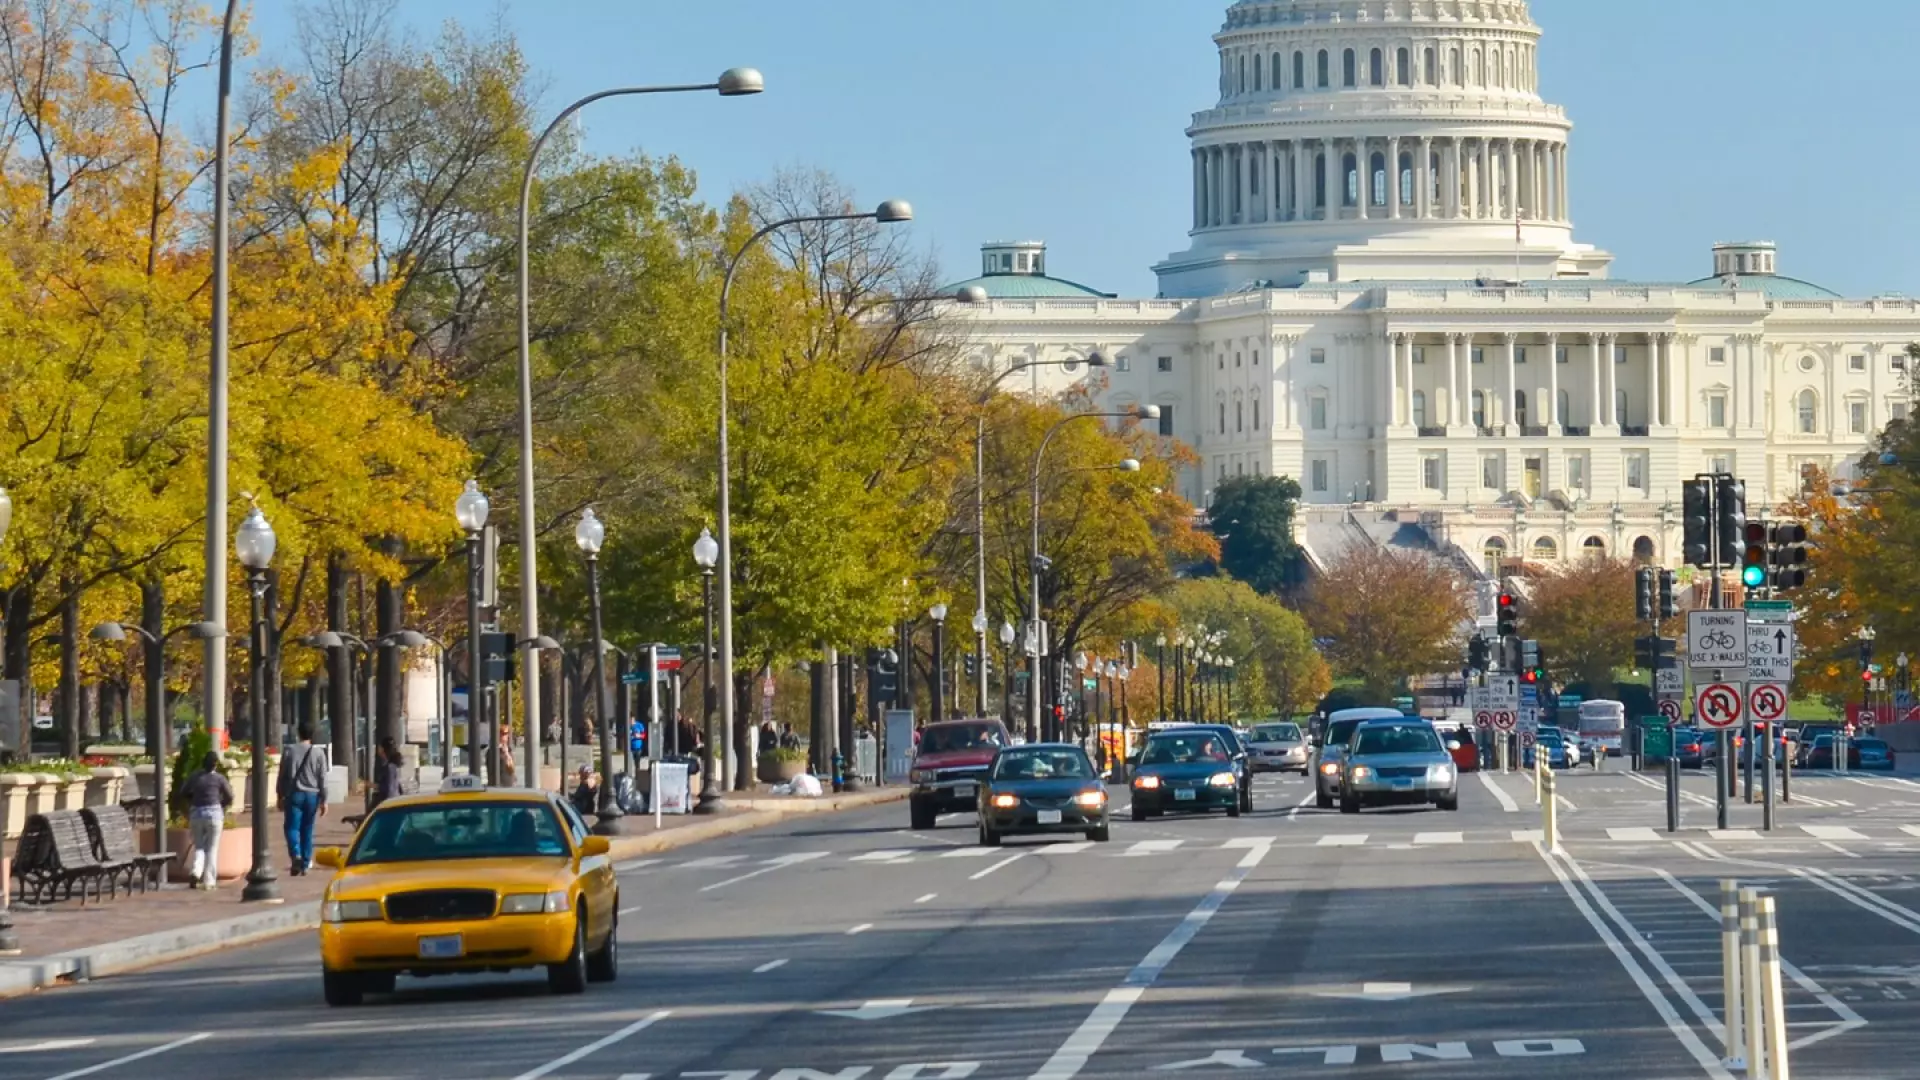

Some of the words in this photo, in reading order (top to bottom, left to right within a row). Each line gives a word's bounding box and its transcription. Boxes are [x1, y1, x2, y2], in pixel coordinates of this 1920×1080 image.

[1700, 615, 1735, 626] TURNING
[1747, 626, 1769, 637] THRU
[1690, 652, 1706, 663] USE
[1711, 651, 1745, 662] X-WALKS
[1748, 656, 1769, 667] OBEY
[1771, 656, 1789, 668] THIS
[1748, 667, 1776, 678] SIGNAL
[451, 777, 473, 789] TAXI
[1145, 1038, 1586, 1070] ONLY
